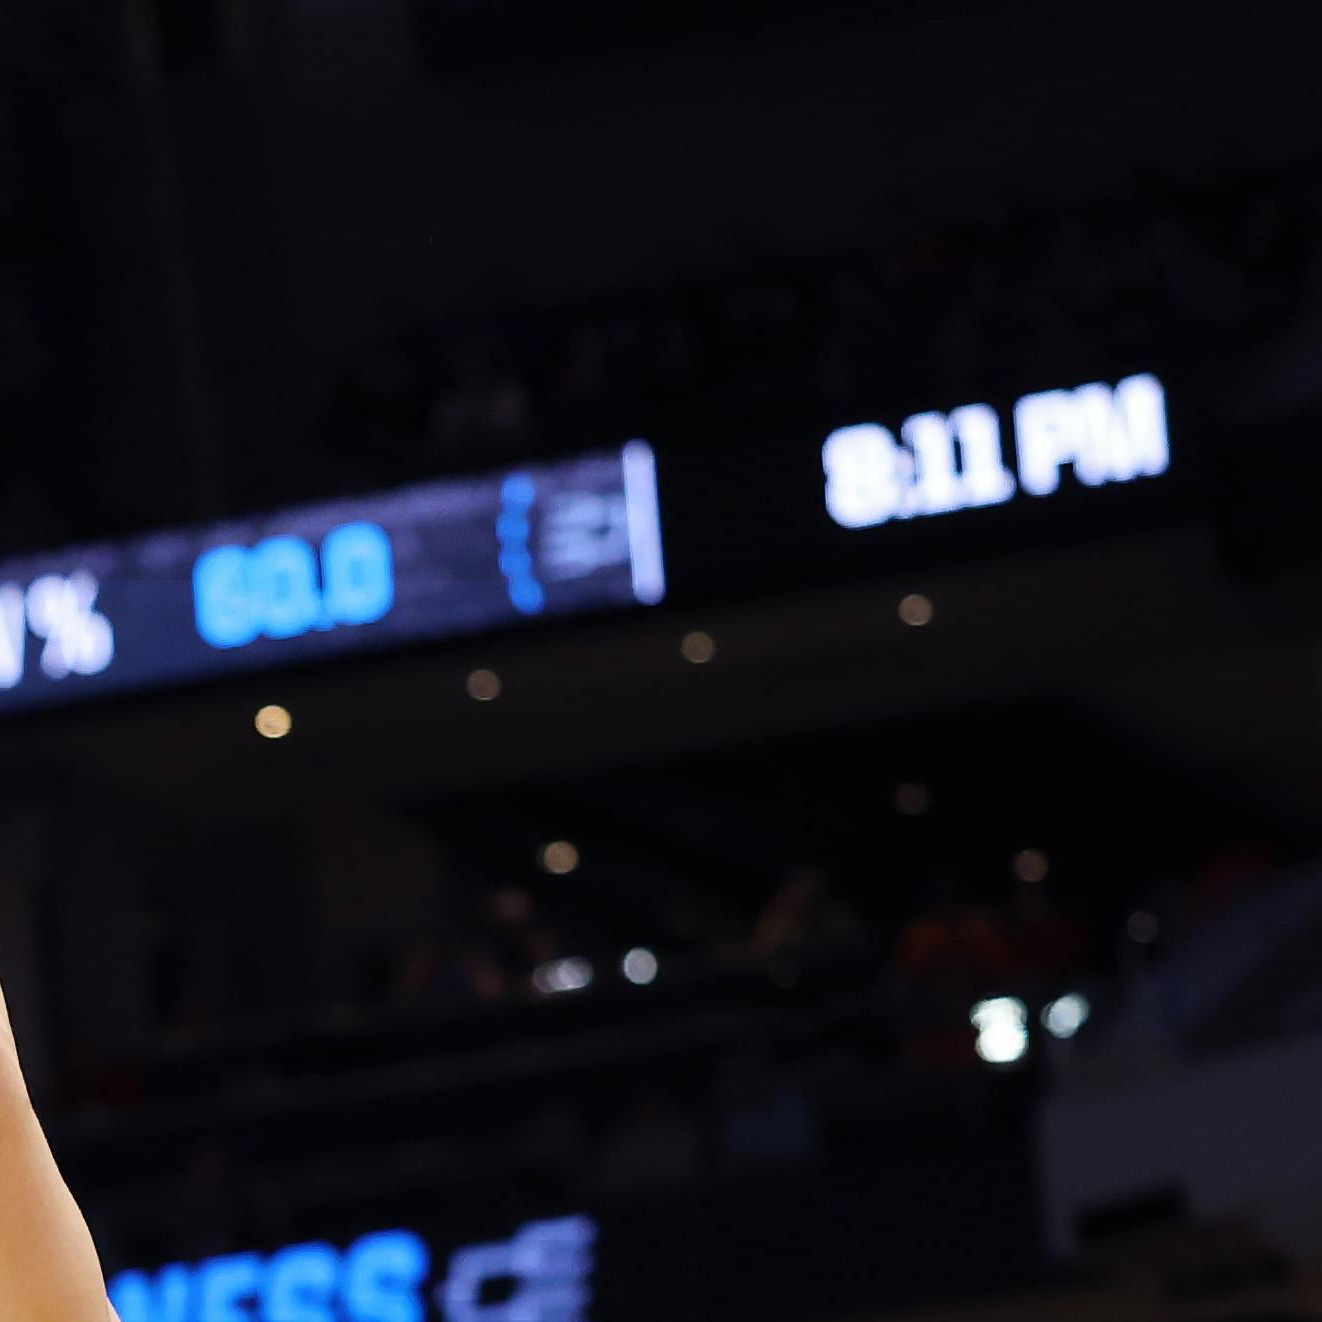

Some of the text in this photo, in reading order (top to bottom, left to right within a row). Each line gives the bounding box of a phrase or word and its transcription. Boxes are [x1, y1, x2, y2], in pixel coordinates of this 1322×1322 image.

[822, 372, 1170, 529] 8:11 PM
[25, 569, 114, 679] %
